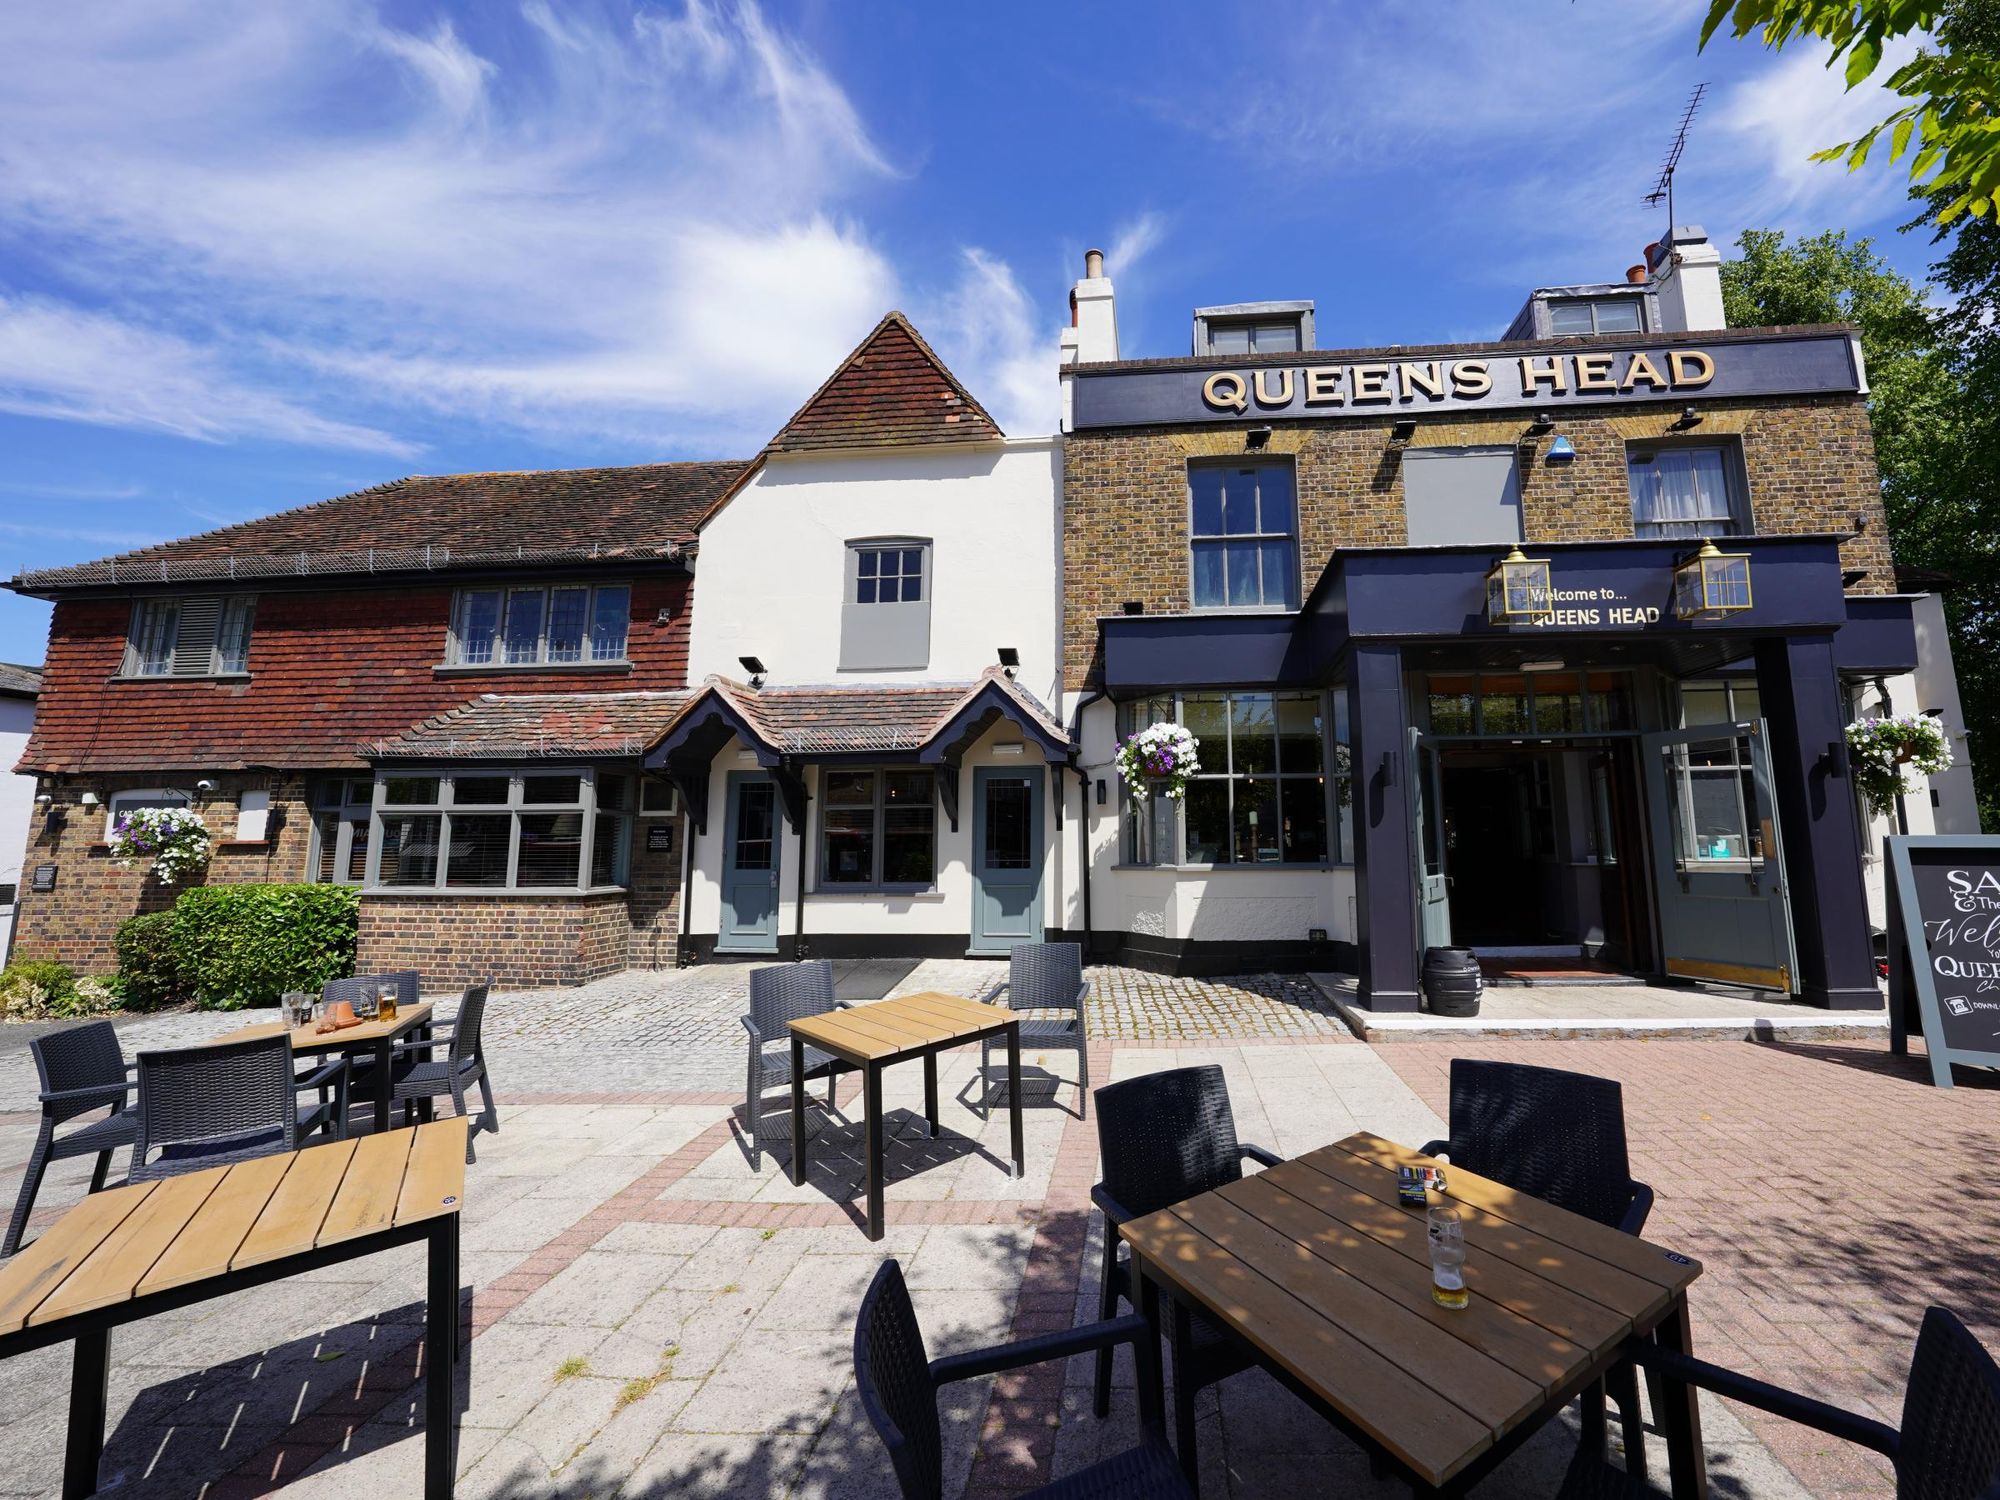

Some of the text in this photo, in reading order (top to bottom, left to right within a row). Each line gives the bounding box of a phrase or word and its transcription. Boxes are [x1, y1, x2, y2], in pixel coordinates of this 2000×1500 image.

[1202, 350, 1716, 414] QUEENS HEAD
[1531, 588, 1598, 602] Welcome
[1609, 607, 1659, 624] HEAD
[1953, 891, 1976, 912] &
[1924, 913, 2000, 949] Wel
[1973, 1002, 2000, 1010] DOWNL
